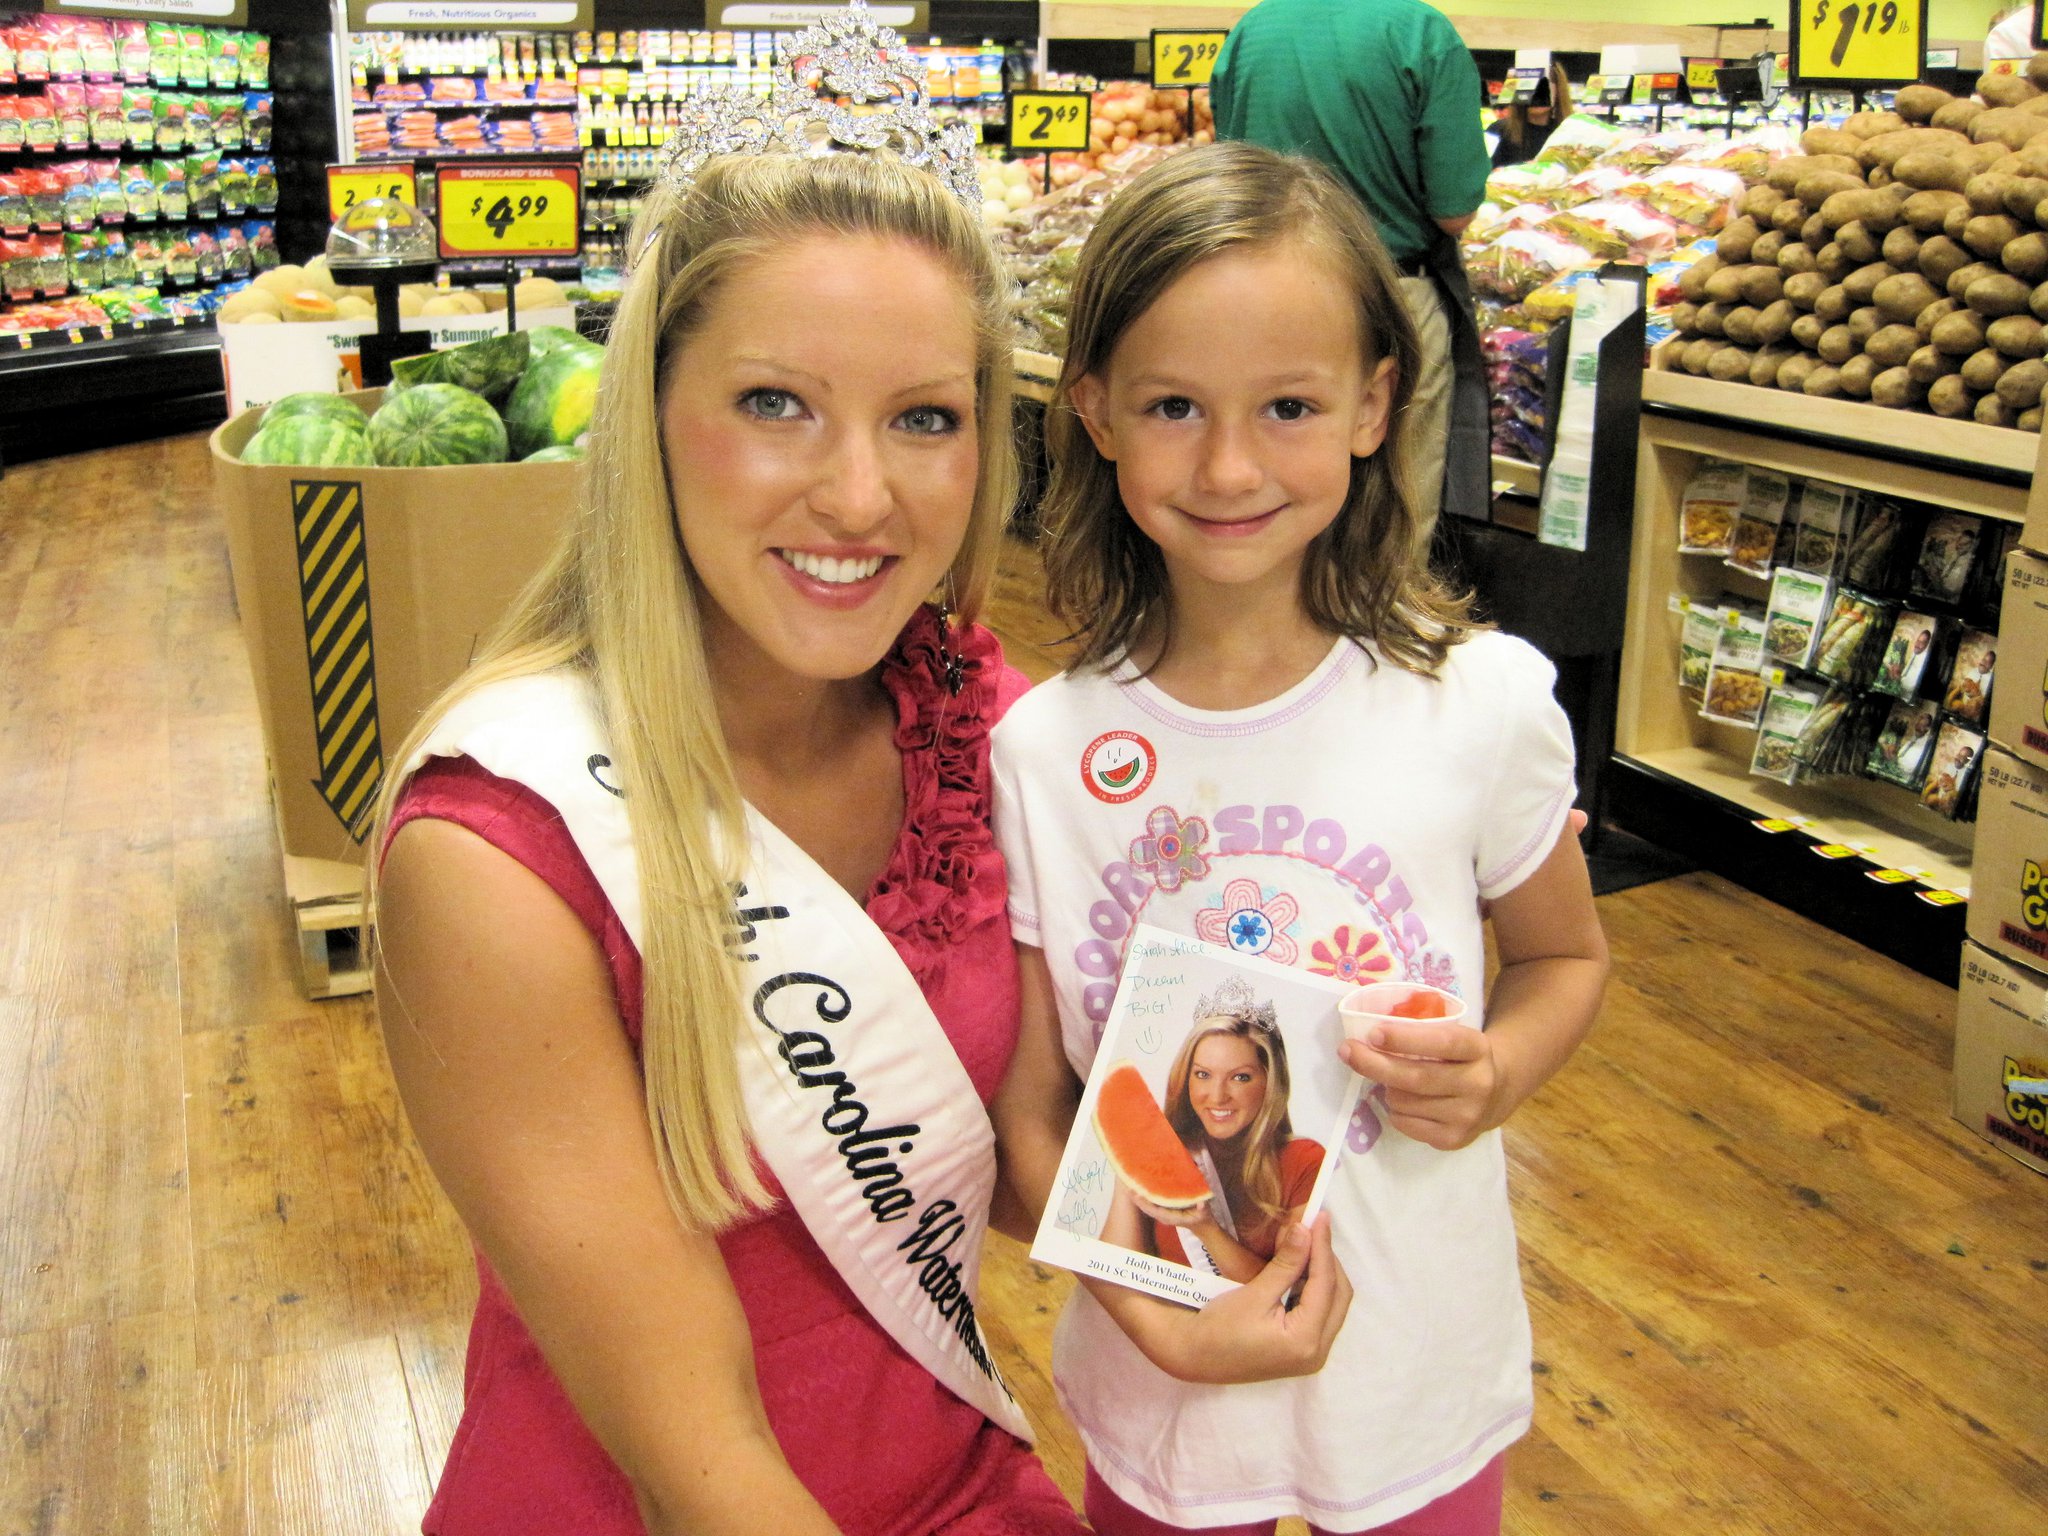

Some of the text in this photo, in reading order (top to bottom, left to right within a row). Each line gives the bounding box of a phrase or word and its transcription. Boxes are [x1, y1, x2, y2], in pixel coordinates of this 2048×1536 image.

[408, 9, 537, 20] Fresh, Nutritious Organics
[528, 169, 556, 178] DEAL
[1083, 732, 1138, 774] LYCOPENE LEADER
[1098, 755, 1155, 802] IN FRESH PRODUCE
[1989, 766, 2000, 778] 50
[2000, 771, 2010, 782] LB
[1968, 962, 1978, 973] 50
[1126, 973, 1186, 993] Dream
[753, 971, 921, 1223] Carolina
[1087, 1259, 1111, 1273] 2011
[1114, 1267, 1129, 1278] SC
[1131, 1272, 1190, 1298] Watermelon
[1125, 1256, 1197, 1286] Holly Whatley
